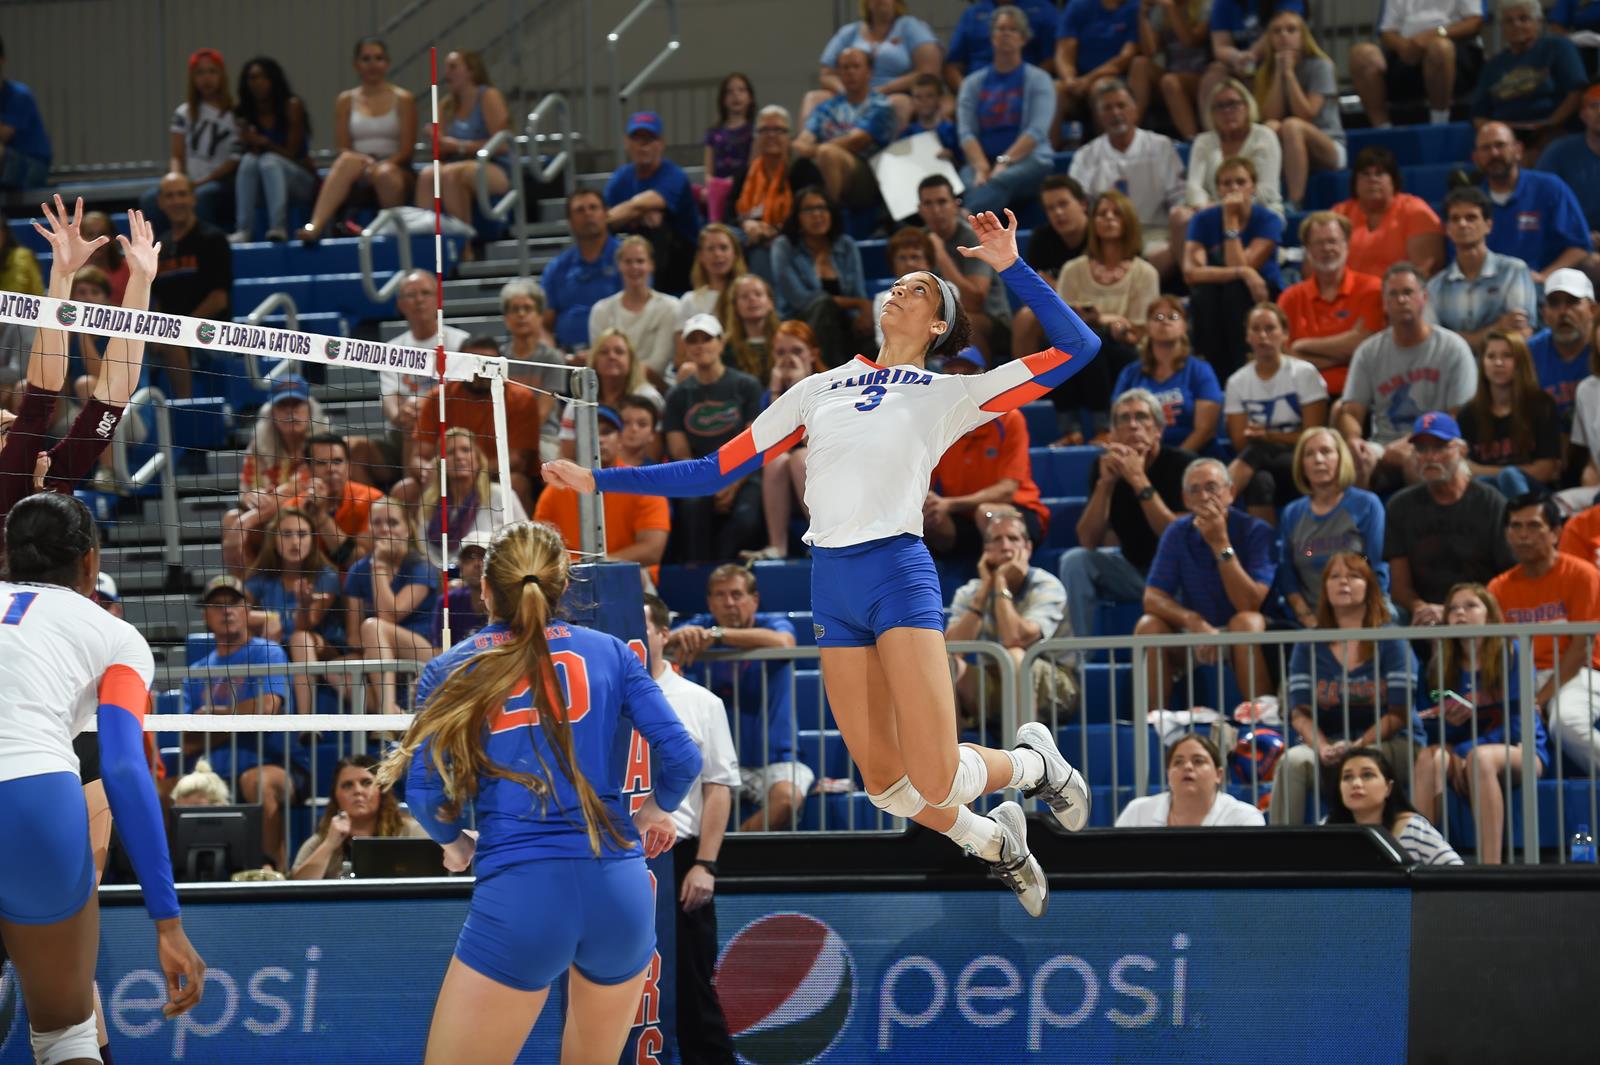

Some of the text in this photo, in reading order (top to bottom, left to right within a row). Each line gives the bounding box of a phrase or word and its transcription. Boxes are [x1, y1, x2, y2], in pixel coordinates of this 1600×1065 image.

[80, 305, 182, 339] FLORIDA GATORS
[218, 324, 311, 355] FLORIDA GATORS
[344, 341, 428, 370] FLORIDA GATORS
[854, 385, 888, 412] 3
[0, 592, 40, 626] 1
[109, 944, 323, 1059] epsi
[877, 931, 1192, 1052] pepsi
